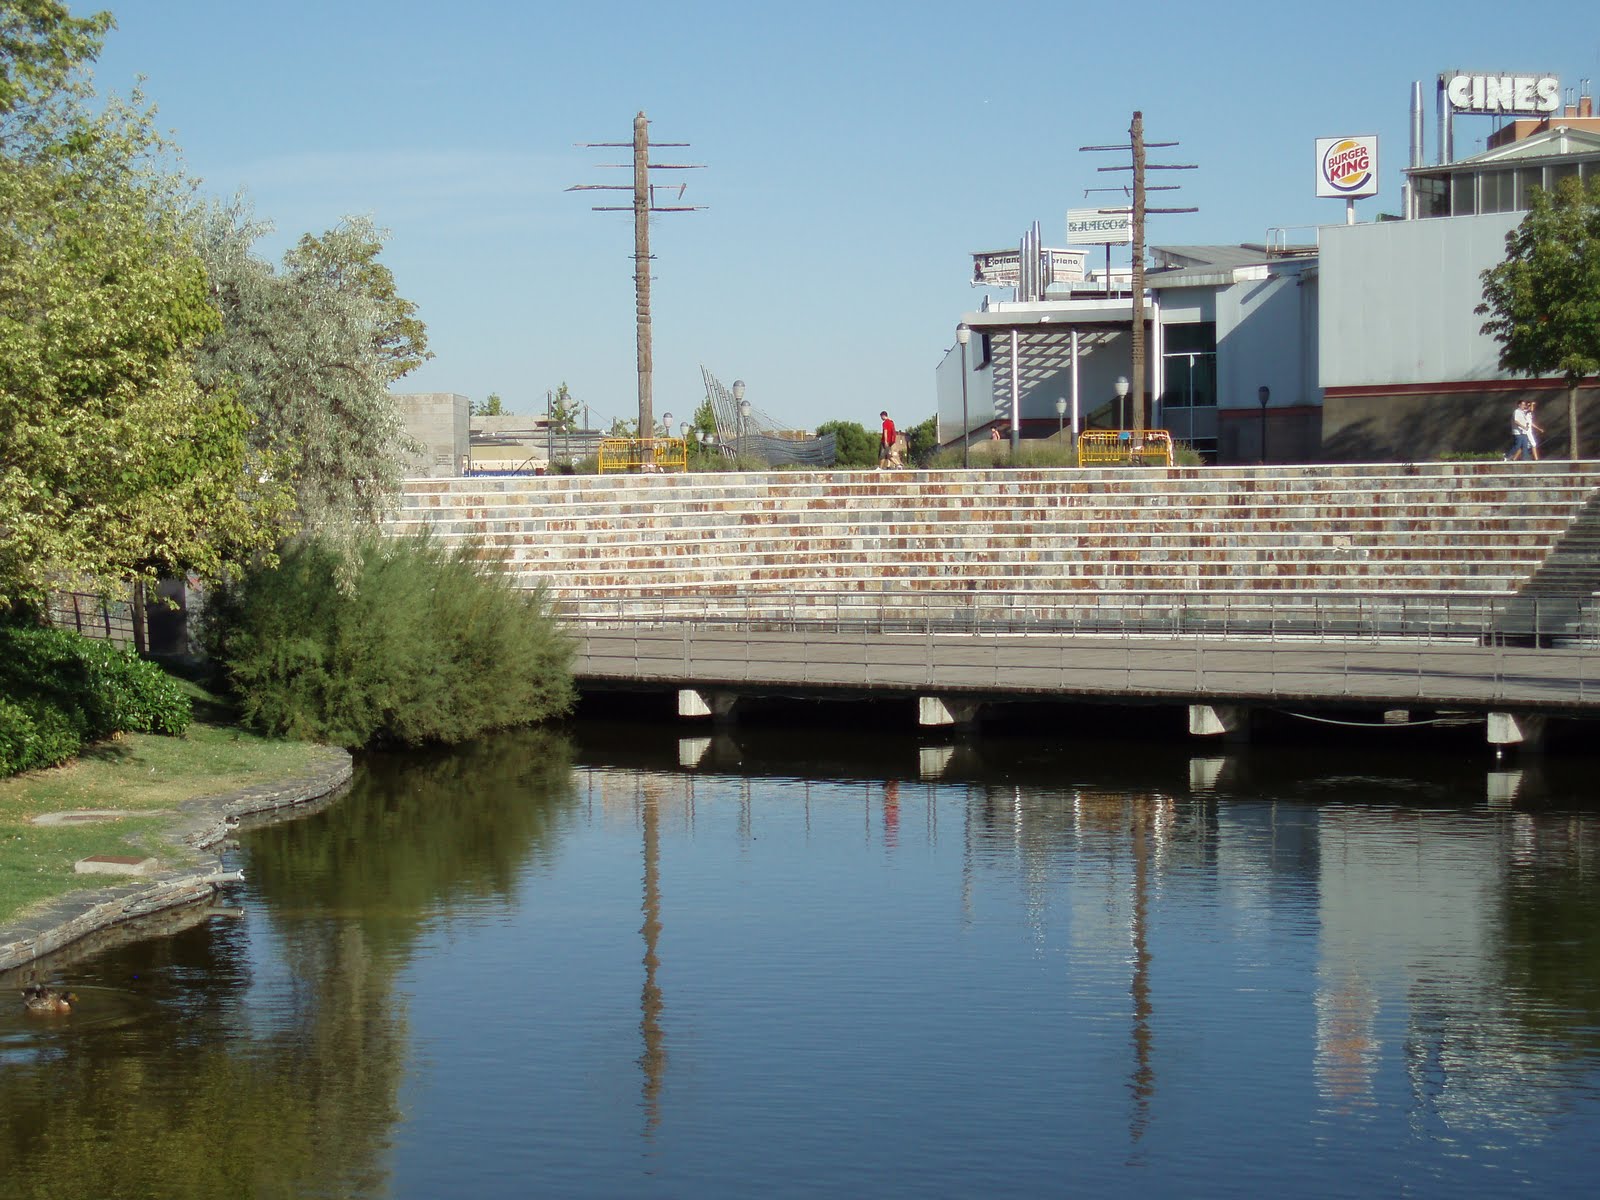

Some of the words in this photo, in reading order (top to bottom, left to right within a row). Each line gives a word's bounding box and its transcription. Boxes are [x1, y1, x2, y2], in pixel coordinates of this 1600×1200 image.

[1447, 75, 1560, 112] CINES
[1328, 146, 1368, 169] BURGER
[1330, 156, 1369, 182] KING
